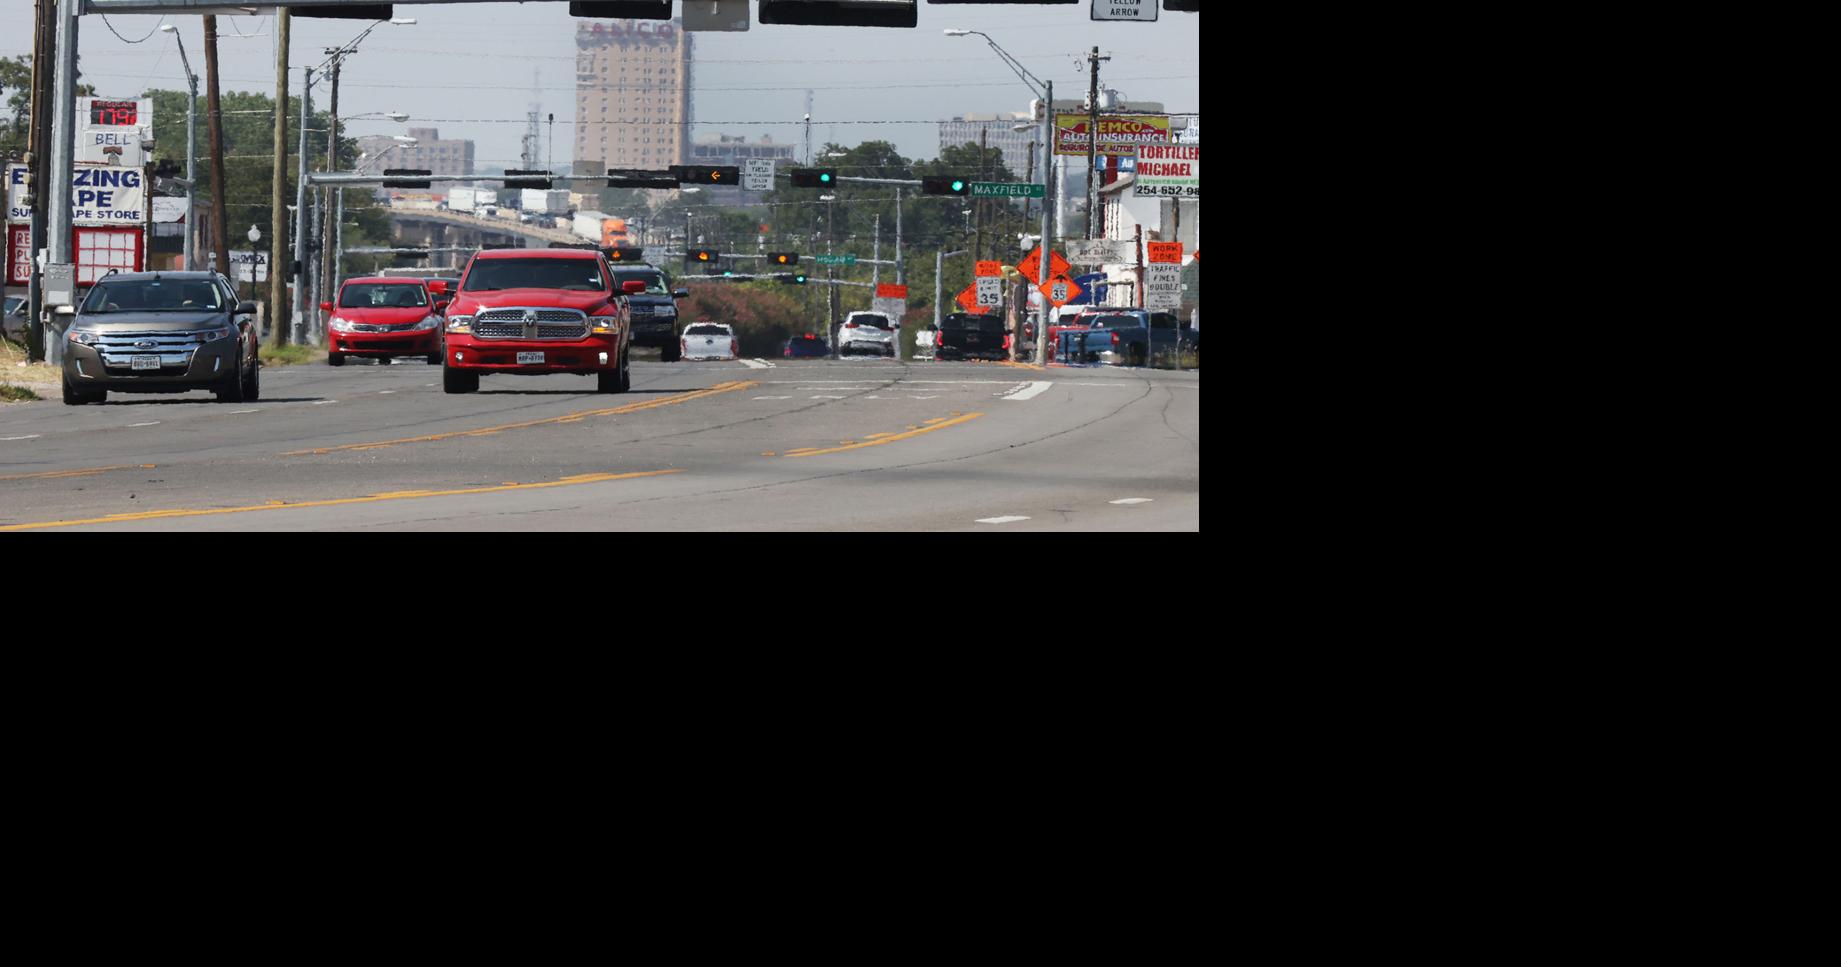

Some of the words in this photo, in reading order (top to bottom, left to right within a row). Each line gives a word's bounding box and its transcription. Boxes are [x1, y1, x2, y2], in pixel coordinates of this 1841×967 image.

[1110, 8, 1139, 17] ARROW
[96, 134, 132, 145] BELL
[1062, 132, 1090, 143] AUT
[1099, 132, 1164, 143] INSURANCE
[1136, 162, 1191, 176] MICHAEL
[974, 185, 1031, 195] MAXFIELD
[98, 210, 140, 220] STORE
[980, 294, 999, 304] 35
[1053, 289, 1065, 300] 35
